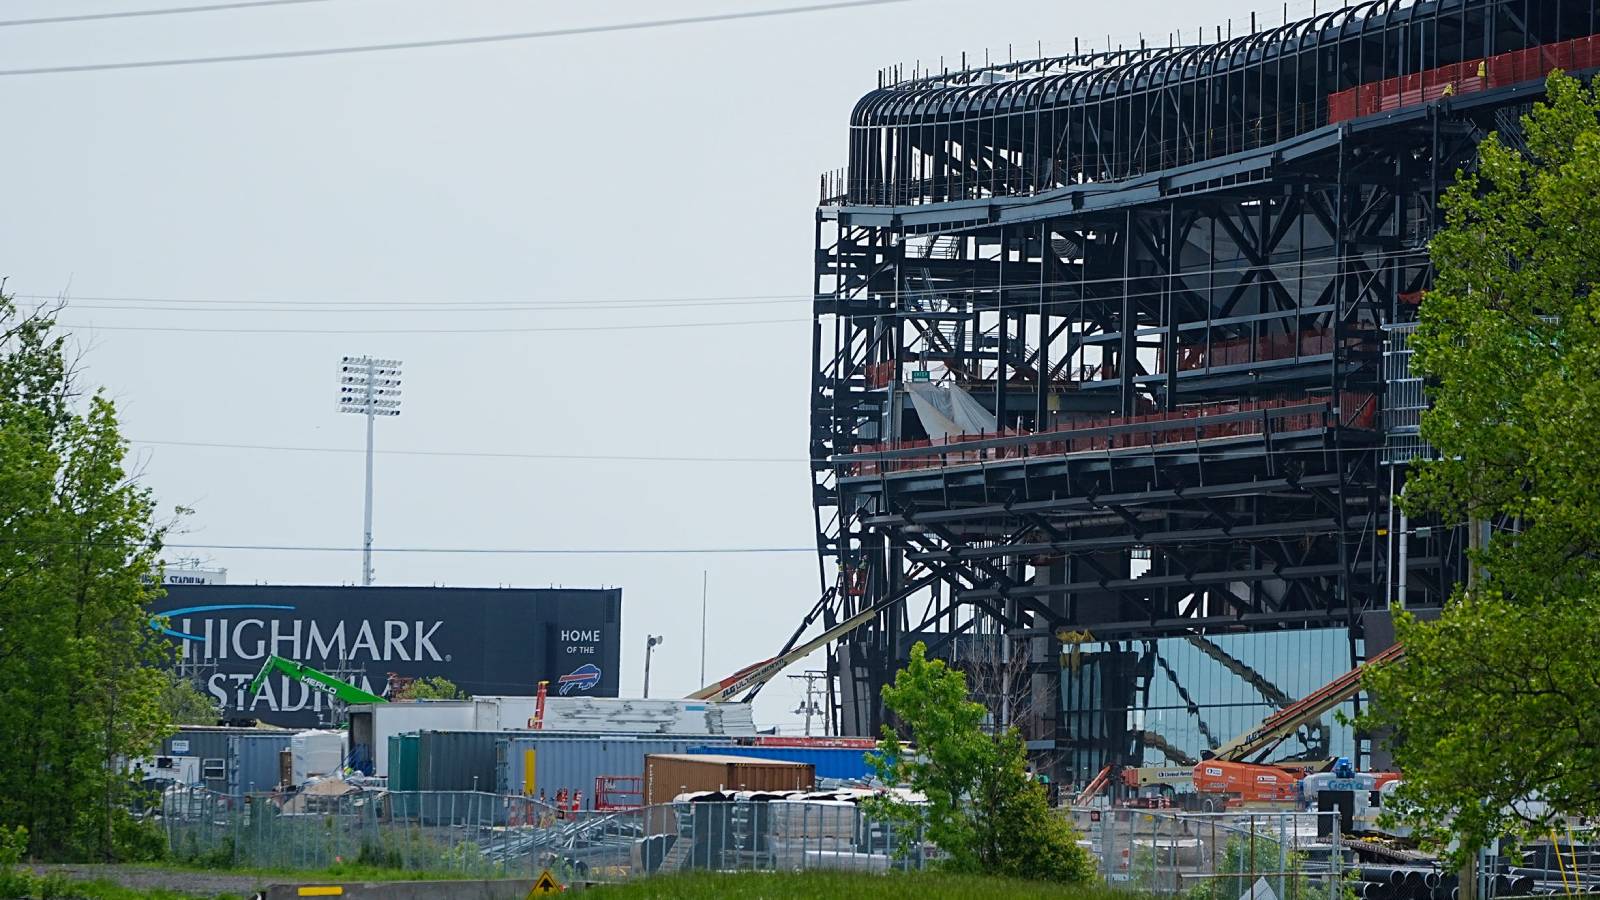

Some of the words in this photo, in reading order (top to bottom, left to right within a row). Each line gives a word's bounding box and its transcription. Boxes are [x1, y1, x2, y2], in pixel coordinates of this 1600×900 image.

[182, 618, 444, 661] HIGHMARK
[561, 630, 600, 641] HOME
[300, 675, 337, 694] MERLO
